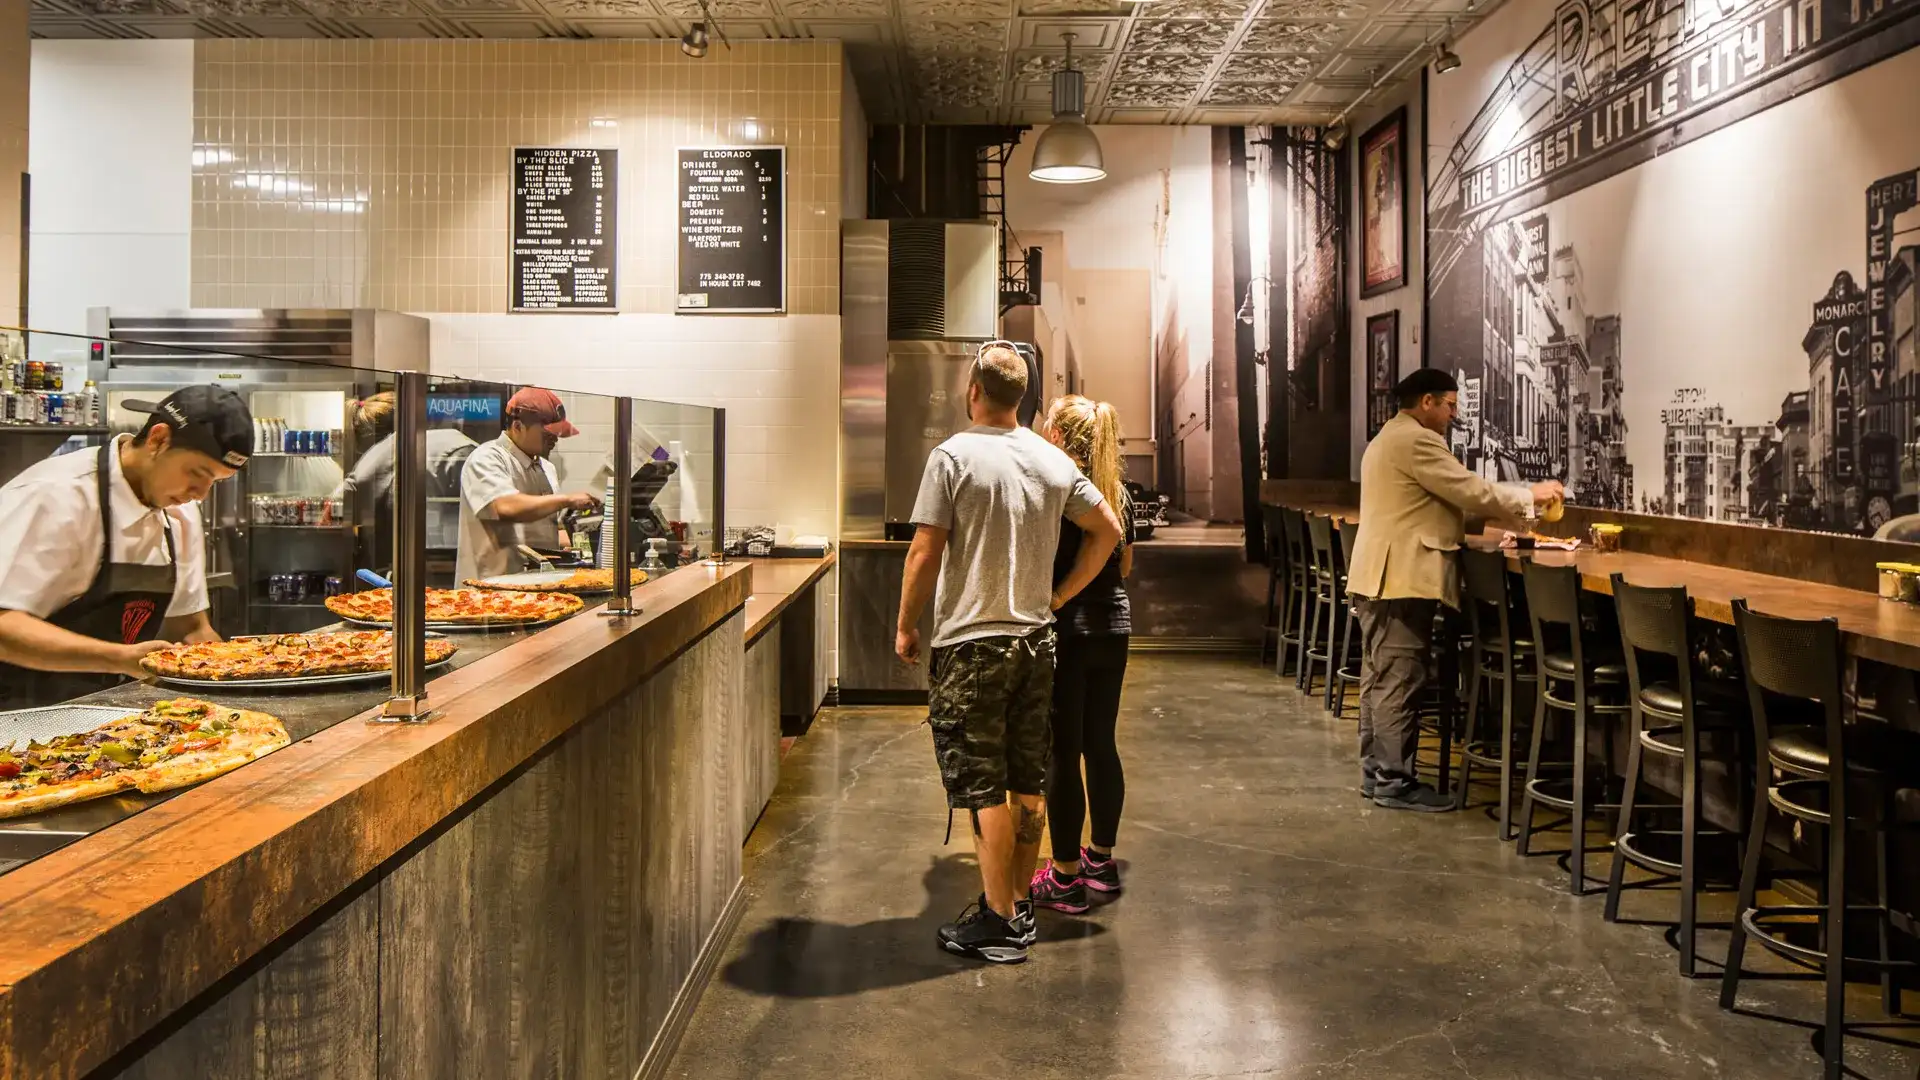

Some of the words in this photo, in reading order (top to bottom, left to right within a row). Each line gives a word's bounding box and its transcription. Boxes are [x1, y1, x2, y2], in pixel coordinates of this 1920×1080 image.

[1461, 167, 1492, 210] THE
[1497, 119, 1582, 194] BIGGEST
[1592, 68, 1678, 149] LITTLE
[1691, 19, 1766, 102] CITY
[682, 161, 718, 169] DRINKS
[681, 200, 704, 208] BEER
[689, 208, 724, 216] DOMESTIC
[1869, 207, 1886, 390] JEWELRY
[1816, 300, 1867, 321] MONARC
[429, 398, 490, 416] AQUAFINA
[1835, 326, 1852, 477] CAFE
[1559, 364, 1568, 470] TANGO
[1521, 451, 1548, 466] TANGO
